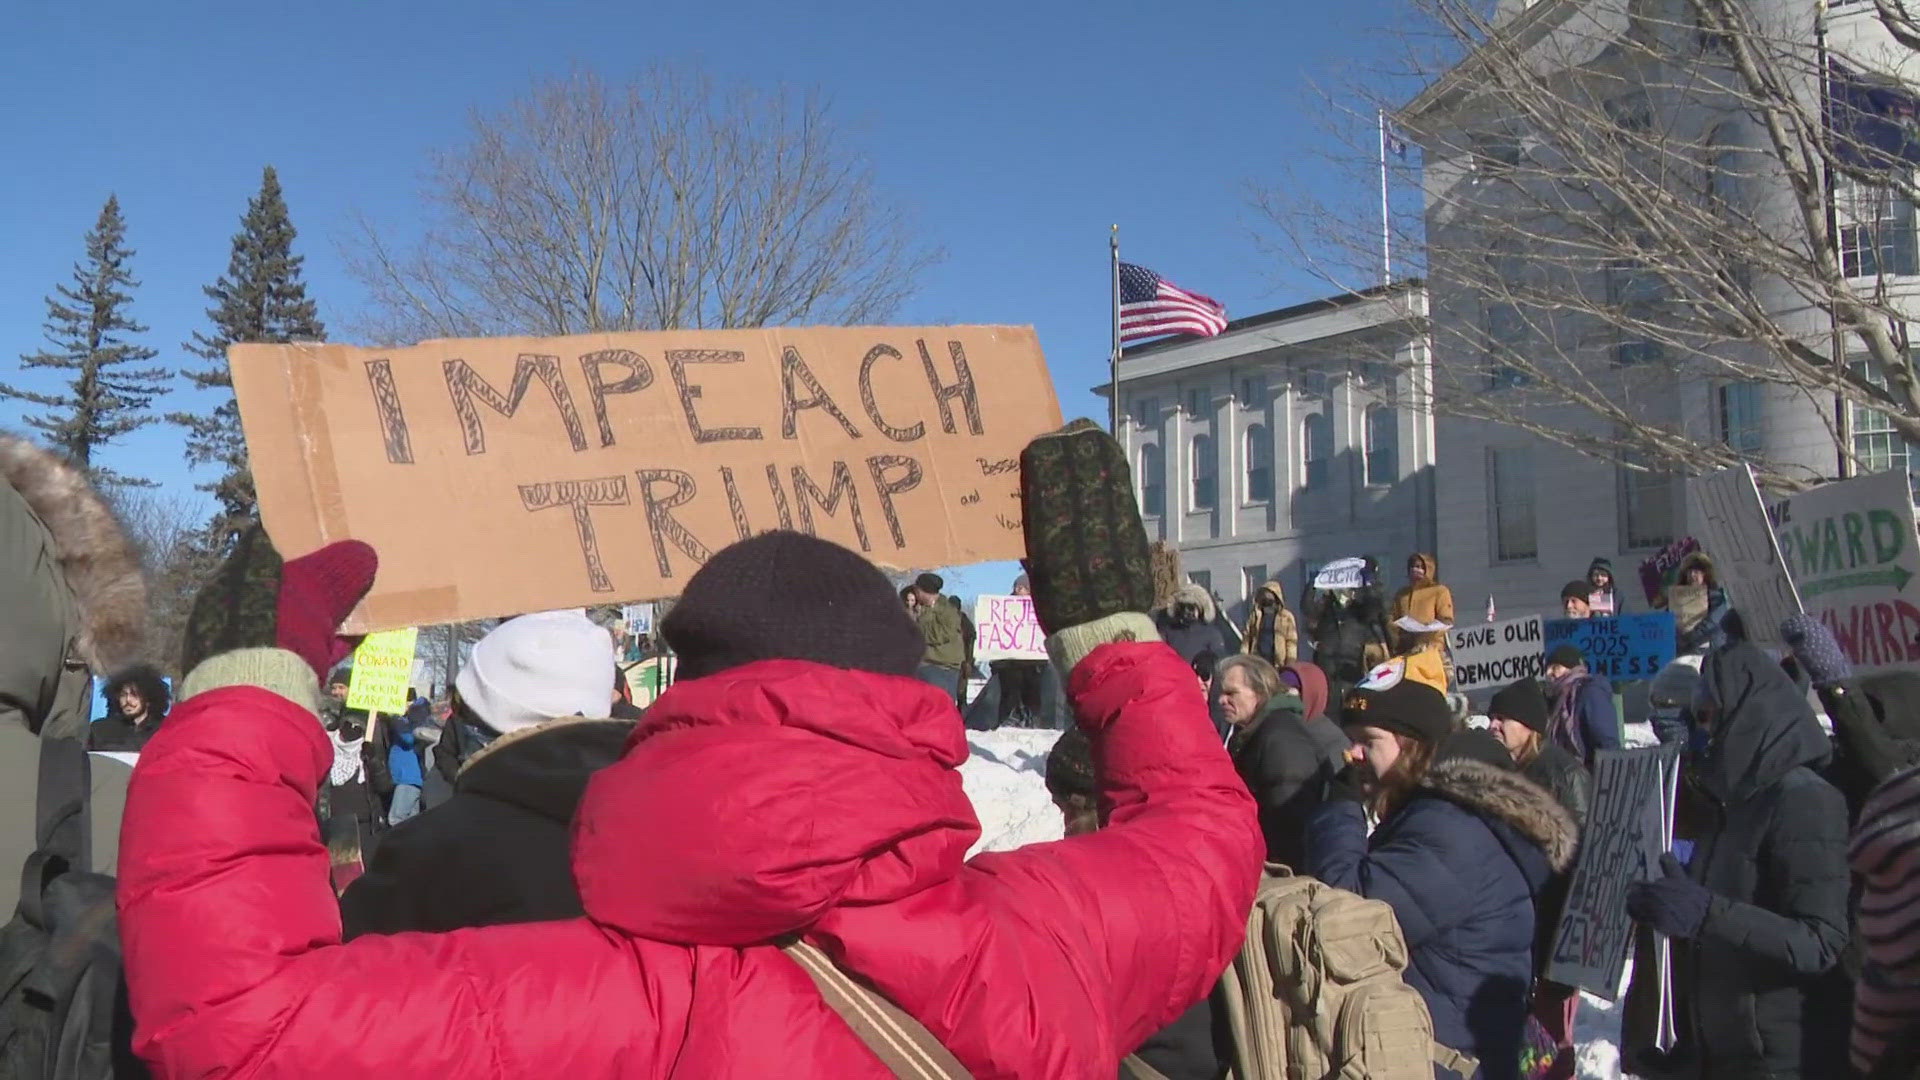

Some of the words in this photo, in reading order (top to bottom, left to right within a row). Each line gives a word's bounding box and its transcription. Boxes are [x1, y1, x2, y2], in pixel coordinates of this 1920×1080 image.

[364, 339, 984, 464] IMPEACH
[518, 456, 923, 592] TRUMP
[991, 598, 1038, 622] REJE
[1455, 628, 1497, 649] SAVE
[1504, 619, 1541, 642] OUR
[1590, 619, 1620, 635] THE
[1579, 635, 1631, 656] 2025
[1456, 652, 1546, 686] DEMOCRACY
